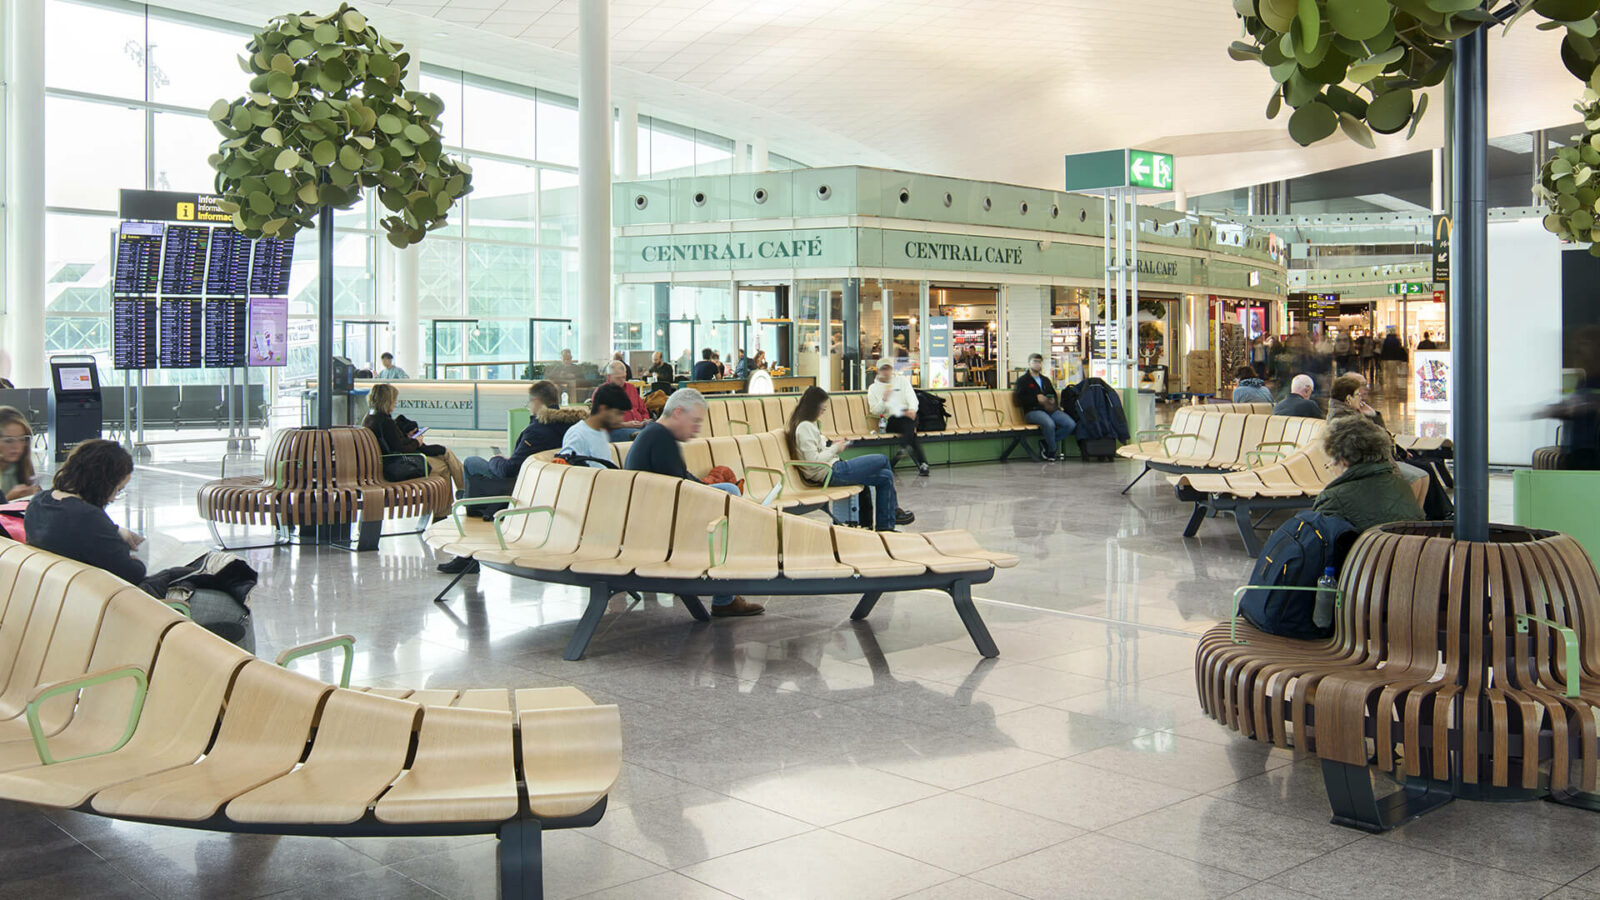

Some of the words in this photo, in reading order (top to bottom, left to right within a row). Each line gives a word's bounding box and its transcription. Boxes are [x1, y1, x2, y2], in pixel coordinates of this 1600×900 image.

[641, 242, 753, 263] CENTRAL
[758, 235, 823, 259] CAFÉ
[904, 240, 983, 262] CENTRAL
[985, 245, 1023, 265] CAFÉ
[1155, 260, 1178, 276] CAFÉ
